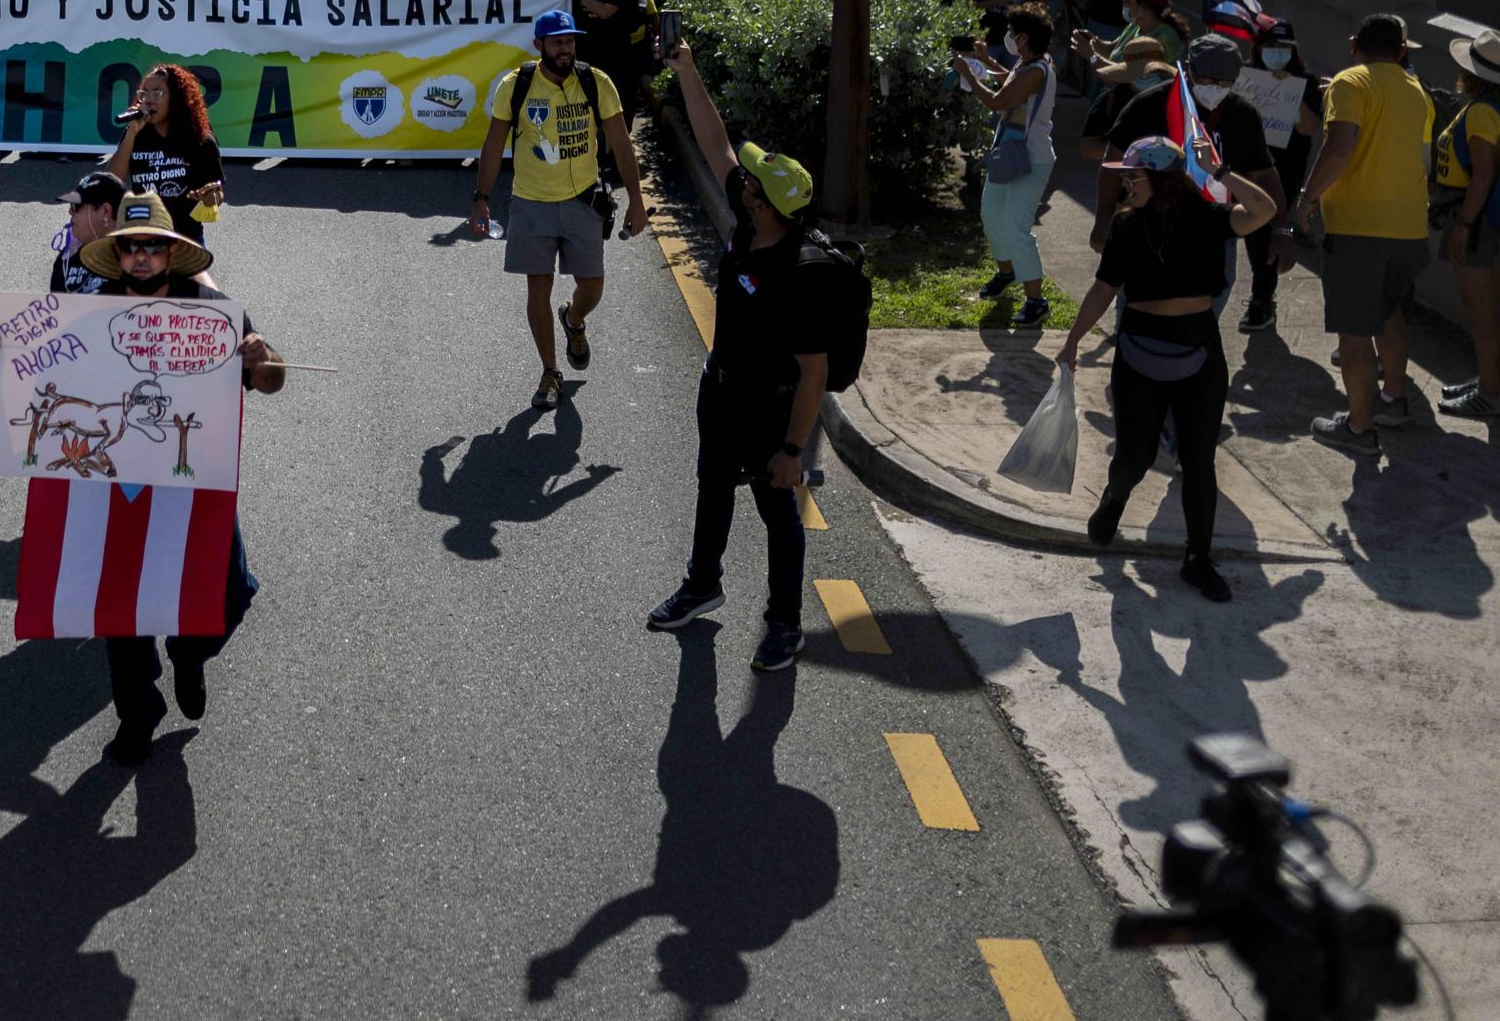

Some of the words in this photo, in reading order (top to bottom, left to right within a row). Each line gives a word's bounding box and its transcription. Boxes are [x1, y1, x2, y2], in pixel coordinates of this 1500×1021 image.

[354, 87, 386, 98] FMPR
[559, 131, 589, 145] RETIRO
[132, 151, 165, 160] USTICIA
[559, 143, 589, 160] DIGNO
[160, 167, 186, 180] DIGNO
[168, 314, 229, 333] PROTESTA
[14, 317, 59, 346] DIGNO
[117, 332, 124, 345] Y
[128, 332, 141, 341] SE
[188, 333, 215, 345] PERO
[11, 333, 88, 381] AHORA
[170, 342, 227, 358] CLAUDICA
[149, 358, 162, 371] AL
